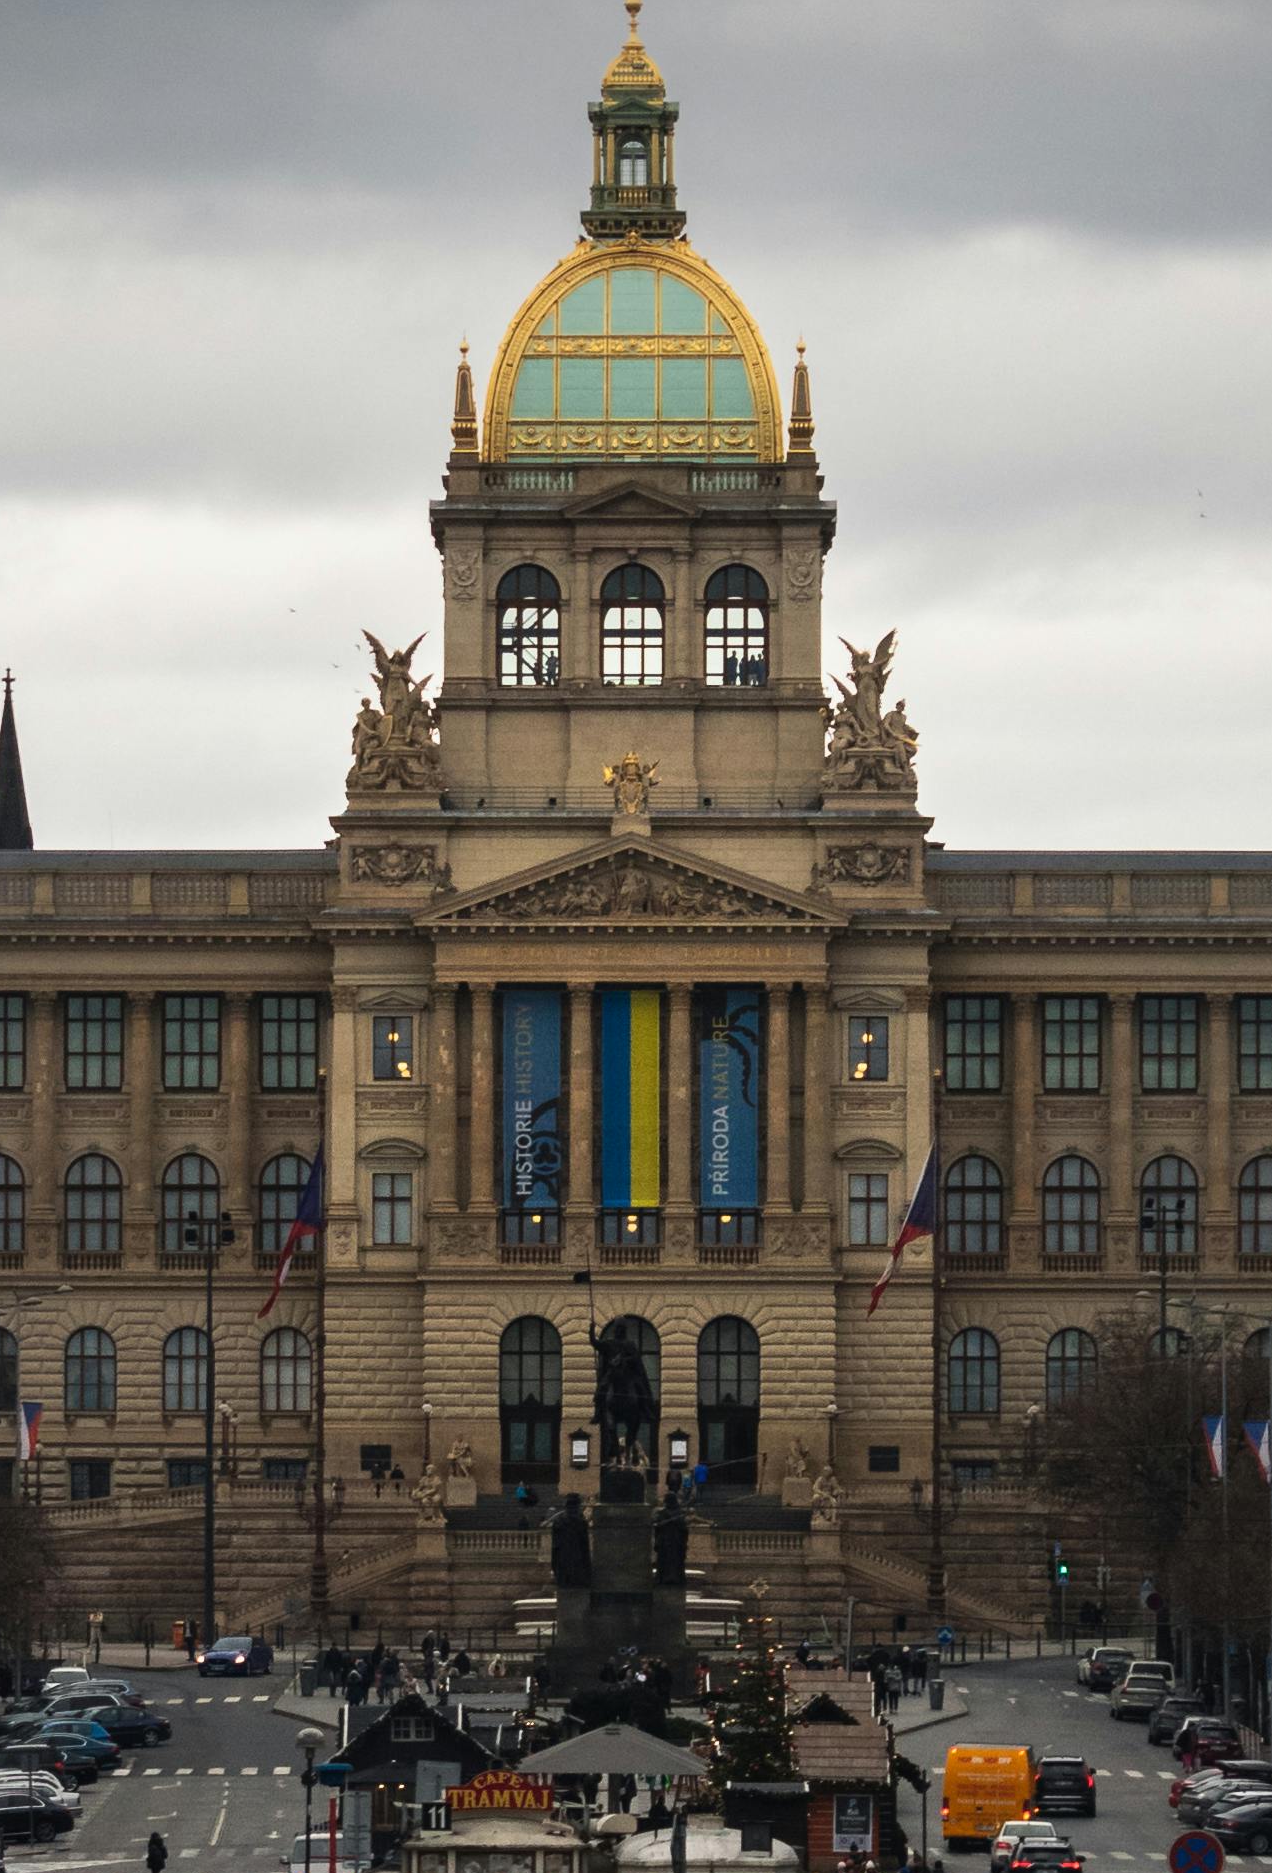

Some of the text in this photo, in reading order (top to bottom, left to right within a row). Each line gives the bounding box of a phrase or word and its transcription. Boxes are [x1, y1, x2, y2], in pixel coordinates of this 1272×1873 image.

[515, 1004, 533, 1196] HISTORIE HISTORY
[708, 1015, 730, 1196] PŘÍRODA NATURE
[427, 1805, 446, 1829] 11
[448, 1789, 551, 1809] TRAMVAJ
